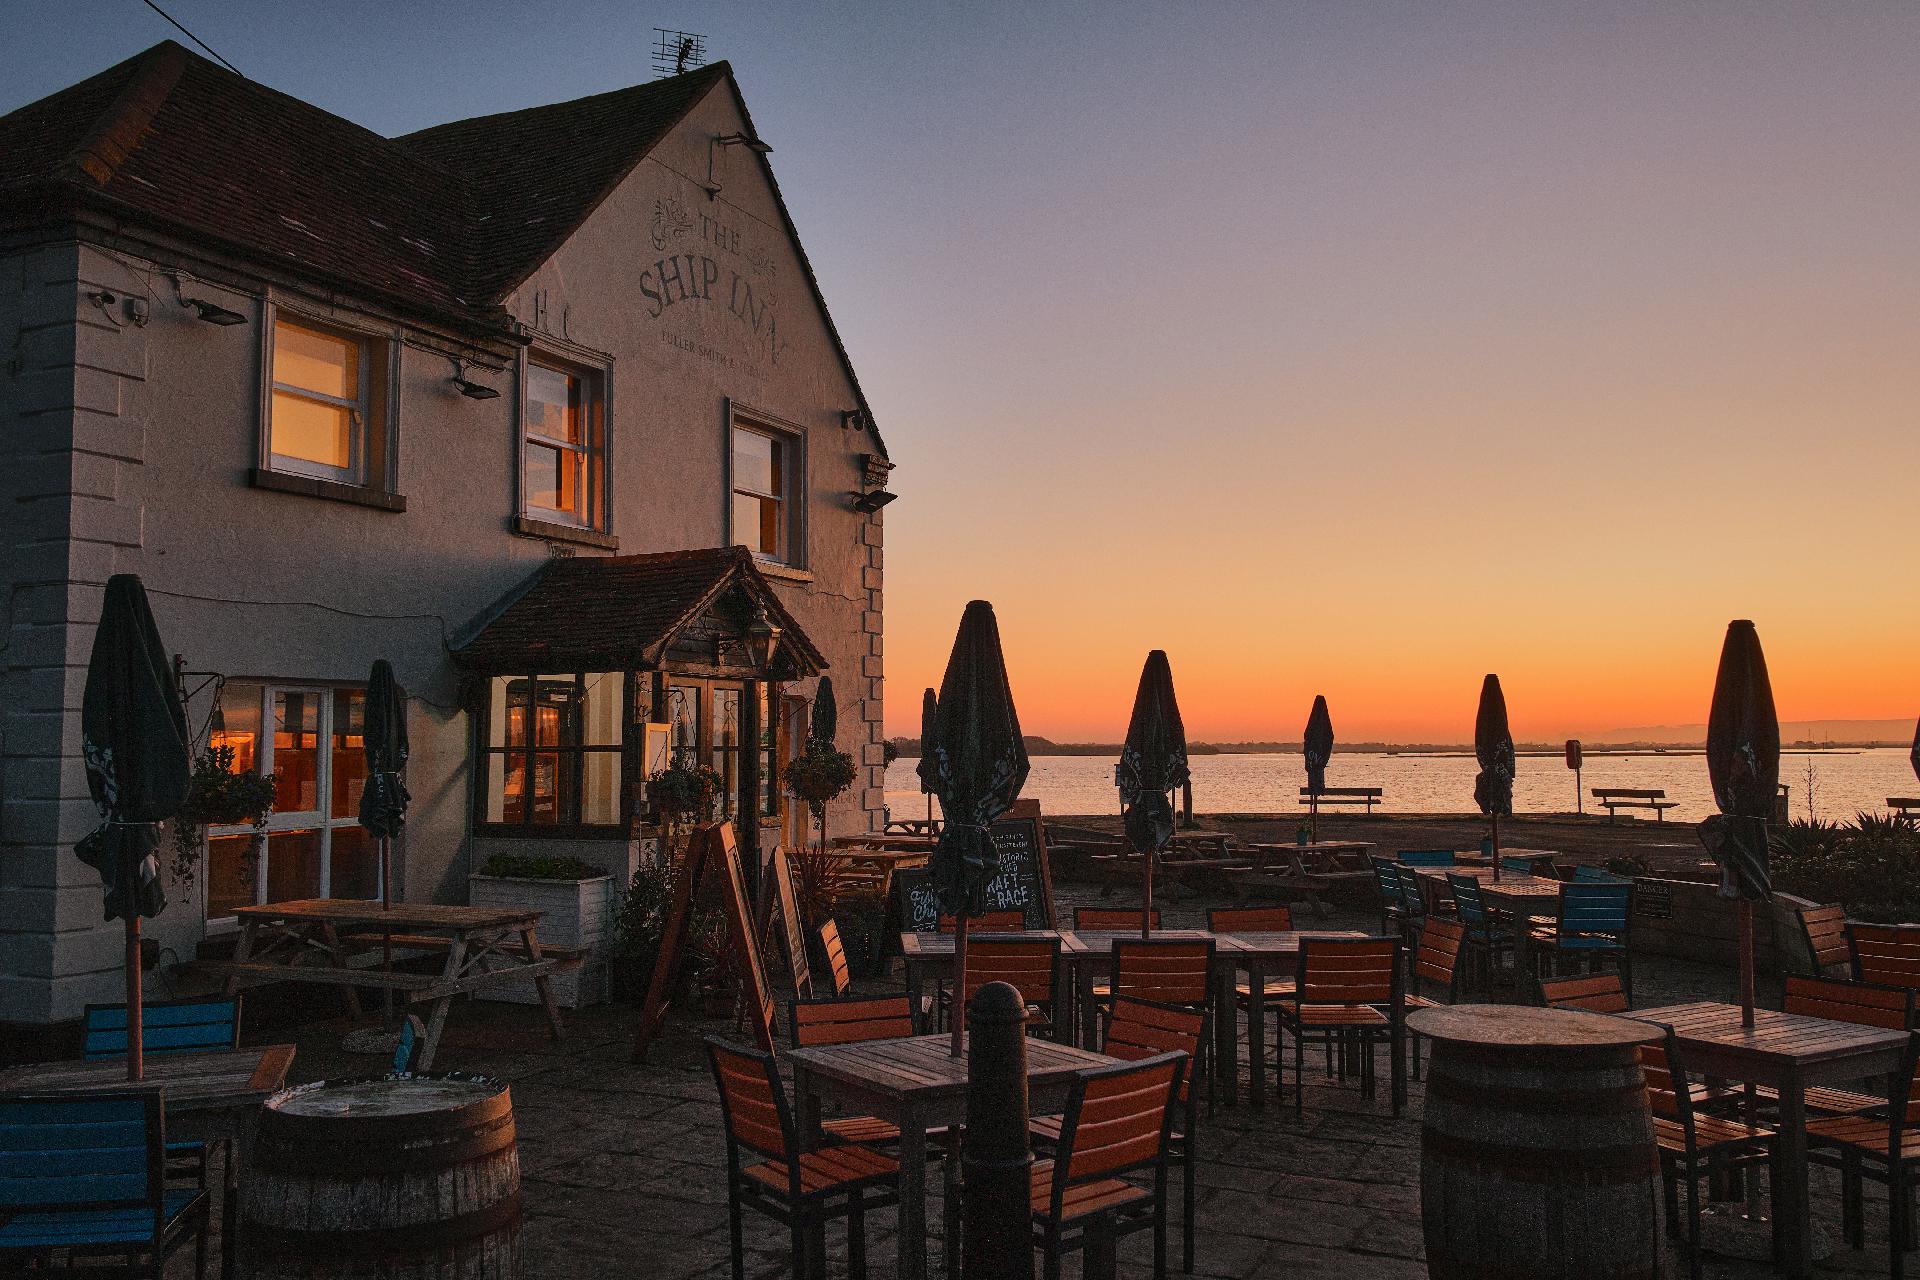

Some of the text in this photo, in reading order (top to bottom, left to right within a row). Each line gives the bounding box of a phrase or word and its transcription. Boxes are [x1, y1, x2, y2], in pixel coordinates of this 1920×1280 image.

[699, 212, 742, 256] THE
[639, 254, 719, 319] SHIP
[728, 270, 788, 365] INN
[697, 344, 727, 367] SMITH
[996, 886, 1029, 910] RACE
[1636, 883, 1669, 895] DANGER
